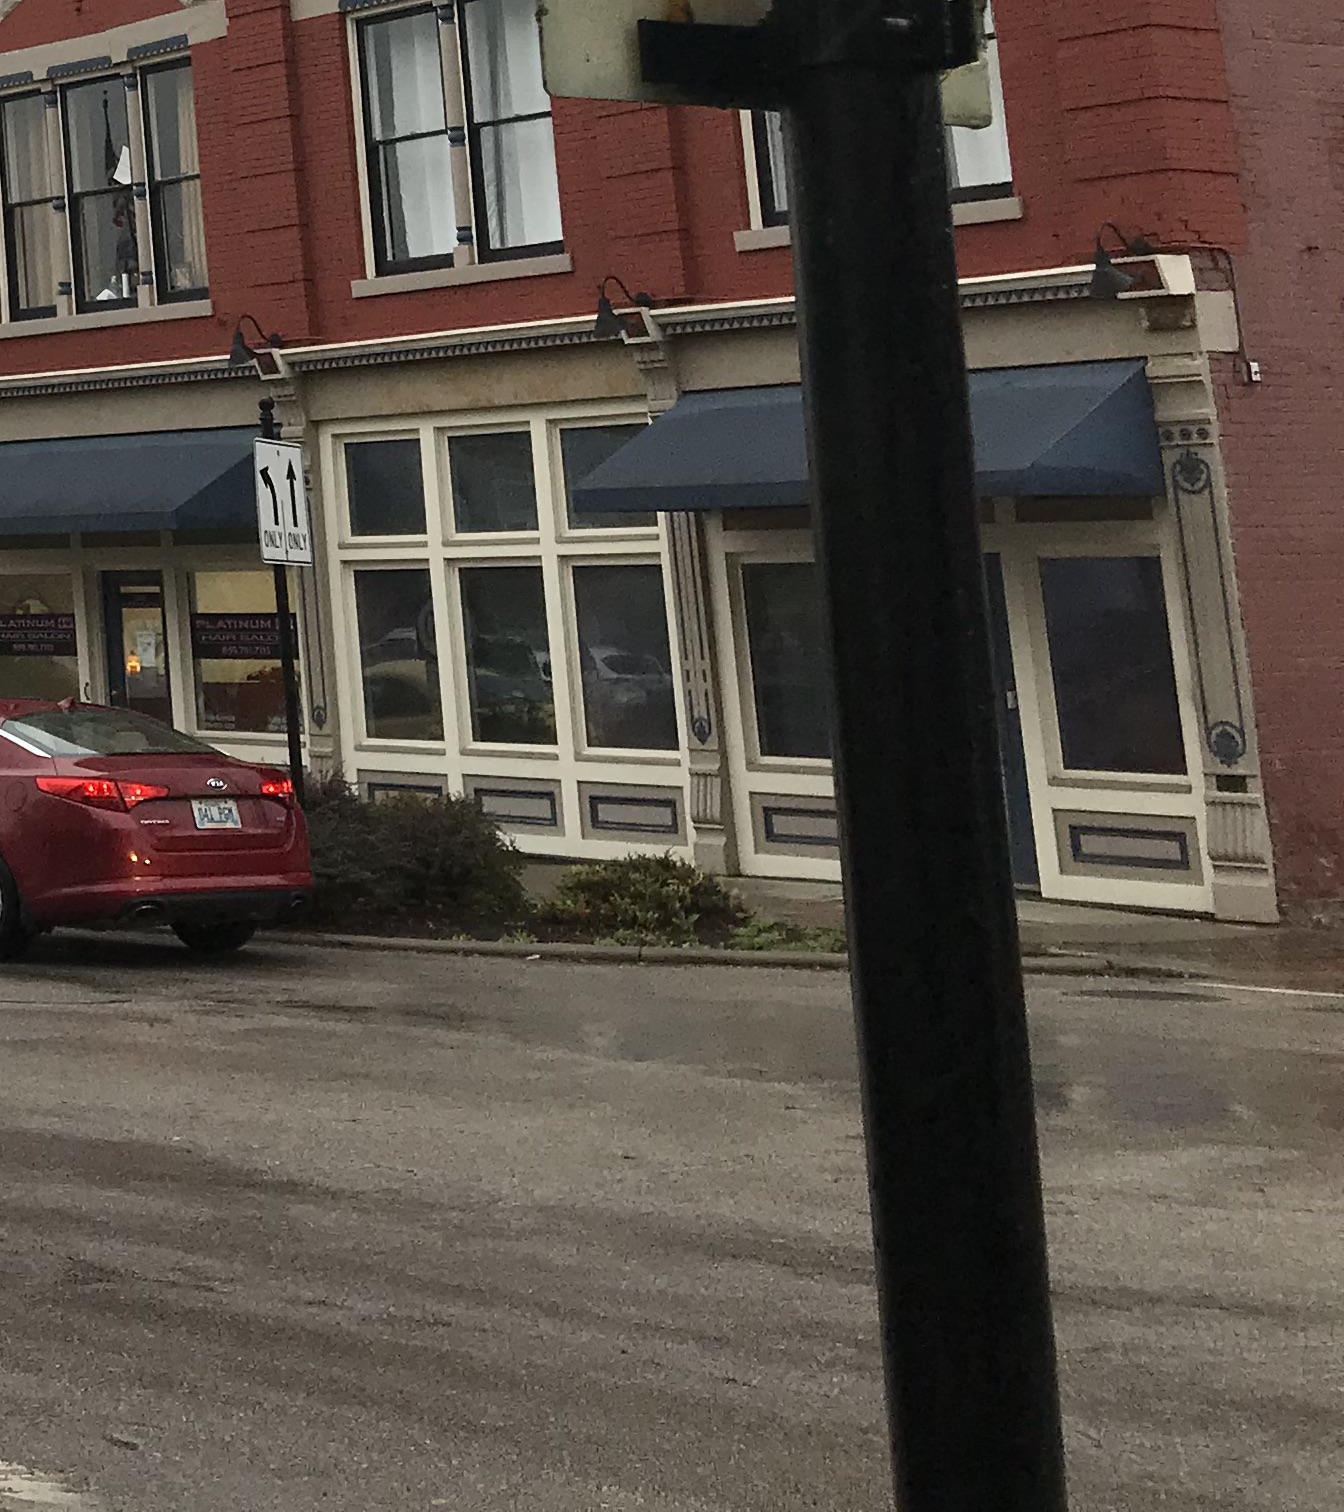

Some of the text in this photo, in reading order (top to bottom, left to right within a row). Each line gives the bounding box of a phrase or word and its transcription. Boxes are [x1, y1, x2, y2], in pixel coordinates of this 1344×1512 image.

[264, 530, 283, 549] ONLY
[288, 532, 307, 550] ONLY
[195, 619, 271, 628] PLATINUM
